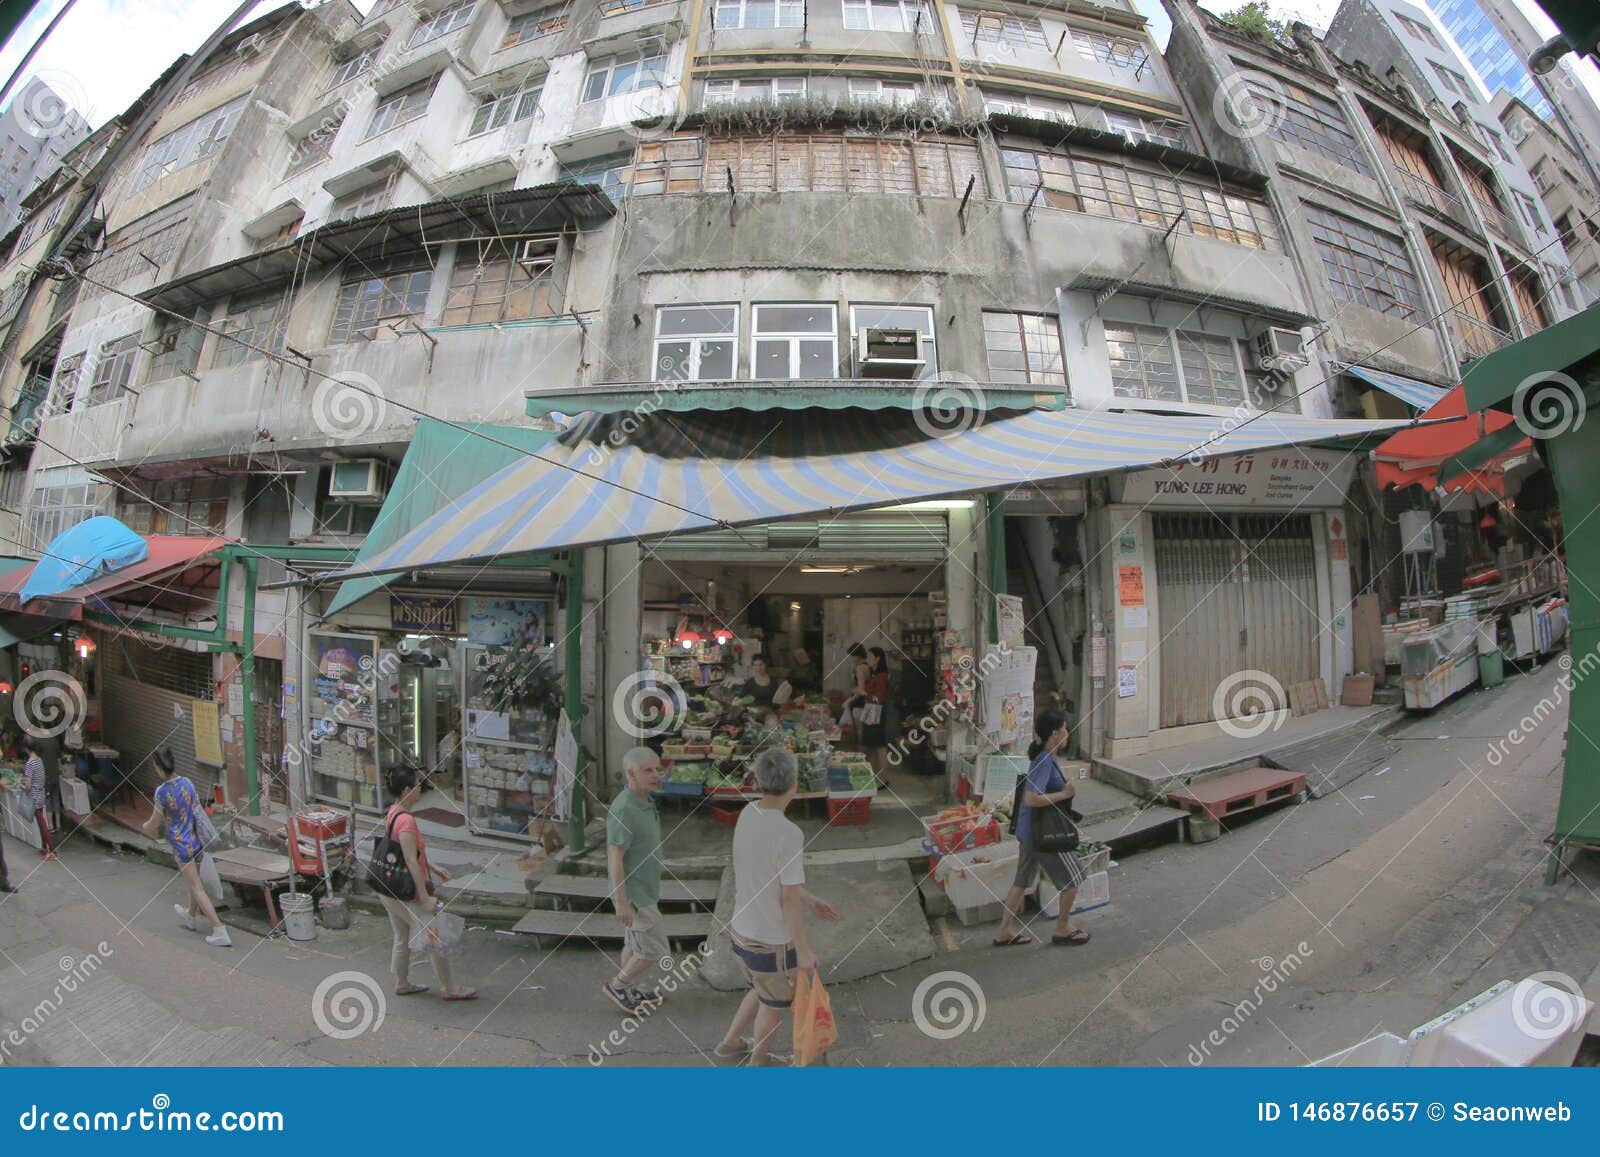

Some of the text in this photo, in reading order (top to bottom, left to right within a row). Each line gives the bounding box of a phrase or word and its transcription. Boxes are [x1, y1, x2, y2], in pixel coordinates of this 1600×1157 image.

[1155, 481, 1247, 495] YUNG LEE HONG
